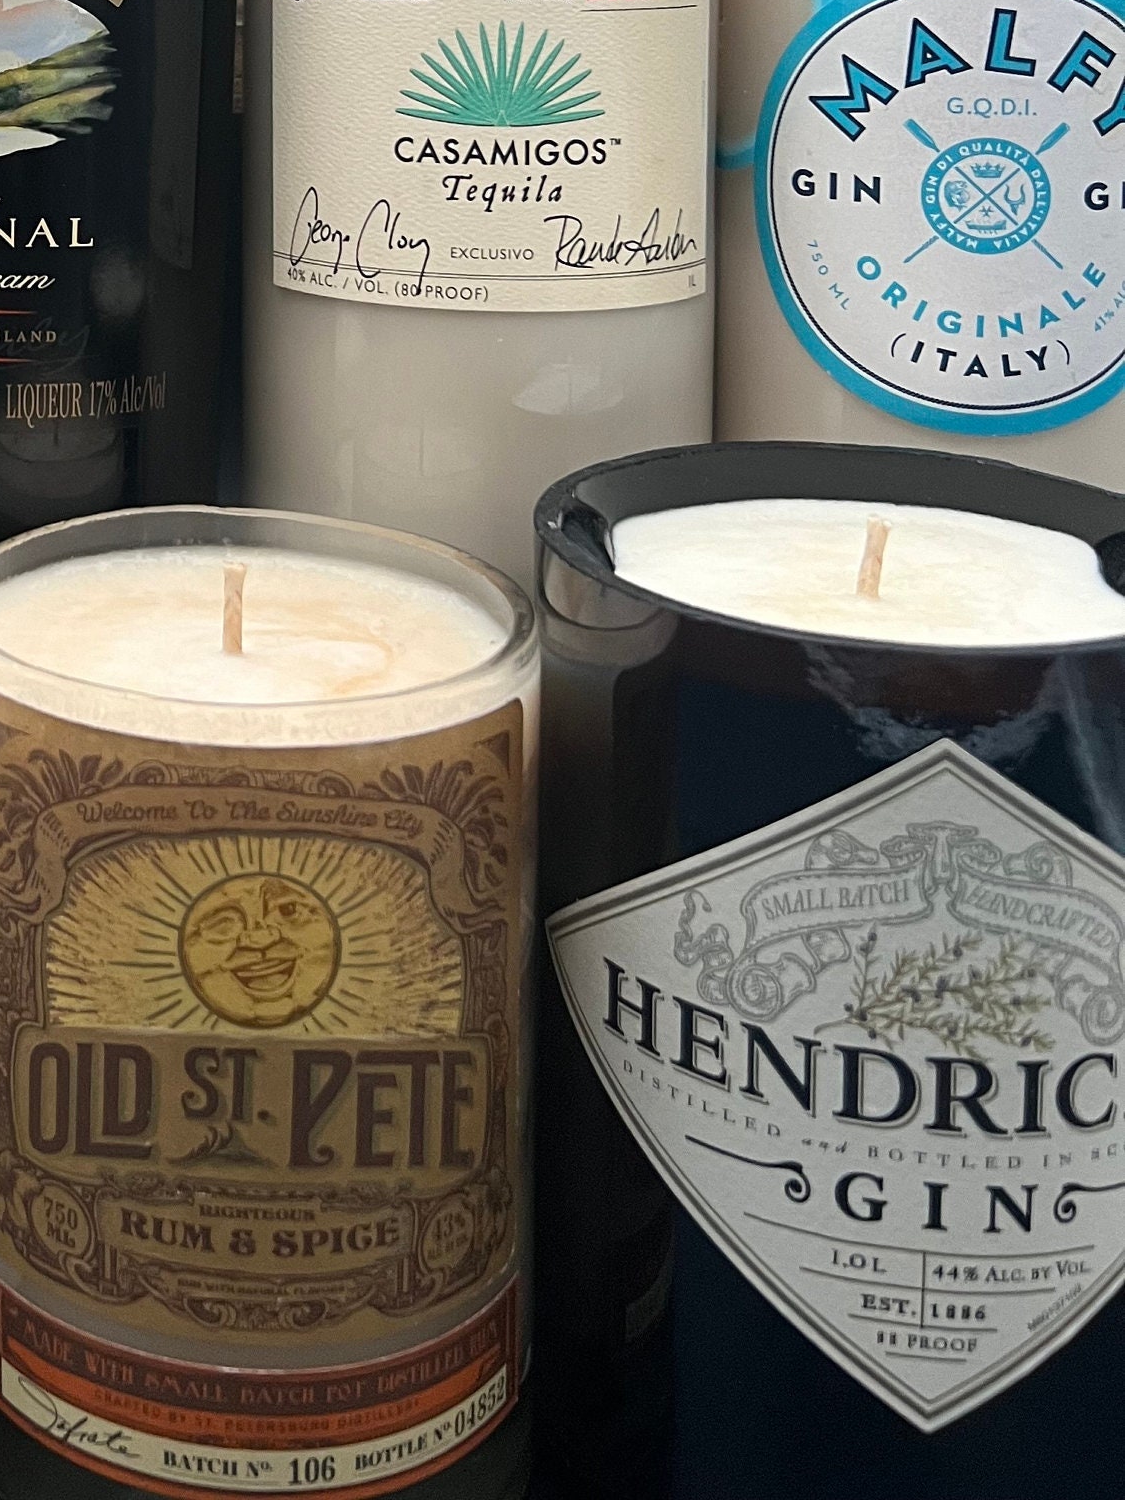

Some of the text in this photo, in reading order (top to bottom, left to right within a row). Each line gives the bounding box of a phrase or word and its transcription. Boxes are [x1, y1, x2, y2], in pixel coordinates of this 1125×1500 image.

[947, 96, 1037, 117] G.Q.D.I.
[394, 136, 607, 166] CASAMIGOS
[442, 174, 563, 212] Tequila
[791, 168, 881, 204] GIN
[450, 247, 534, 261] EXCLUSIVO
[424, 284, 489, 303] PROOF)
[856, 256, 1107, 339] ORIGINALE
[890, 332, 1071, 378] (ITALY)
[6, 371, 167, 428] LIQUEUR 17% Alc/Vol
[77, 800, 424, 836] Welcome Sunshine City
[762, 878, 910, 918] SMALL BATCH
[602, 957, 1125, 1139] HENDRIC
[28, 1041, 476, 1169] OLD ST. PETE
[622, 1057, 1022, 1169] DISTILLED BOTTLED
[834, 1172, 1039, 1233] GIN
[120, 1207, 215, 1254] RUM
[271, 1217, 401, 1257] SPICE
[932, 1263, 979, 1282] 44%
[860, 1293, 916, 1317] EST.
[162, 1448, 239, 1478] BATCH
[287, 1454, 336, 1487] 106
[354, 1436, 428, 1472] BOTTLE
[453, 1375, 507, 1437] 04852
